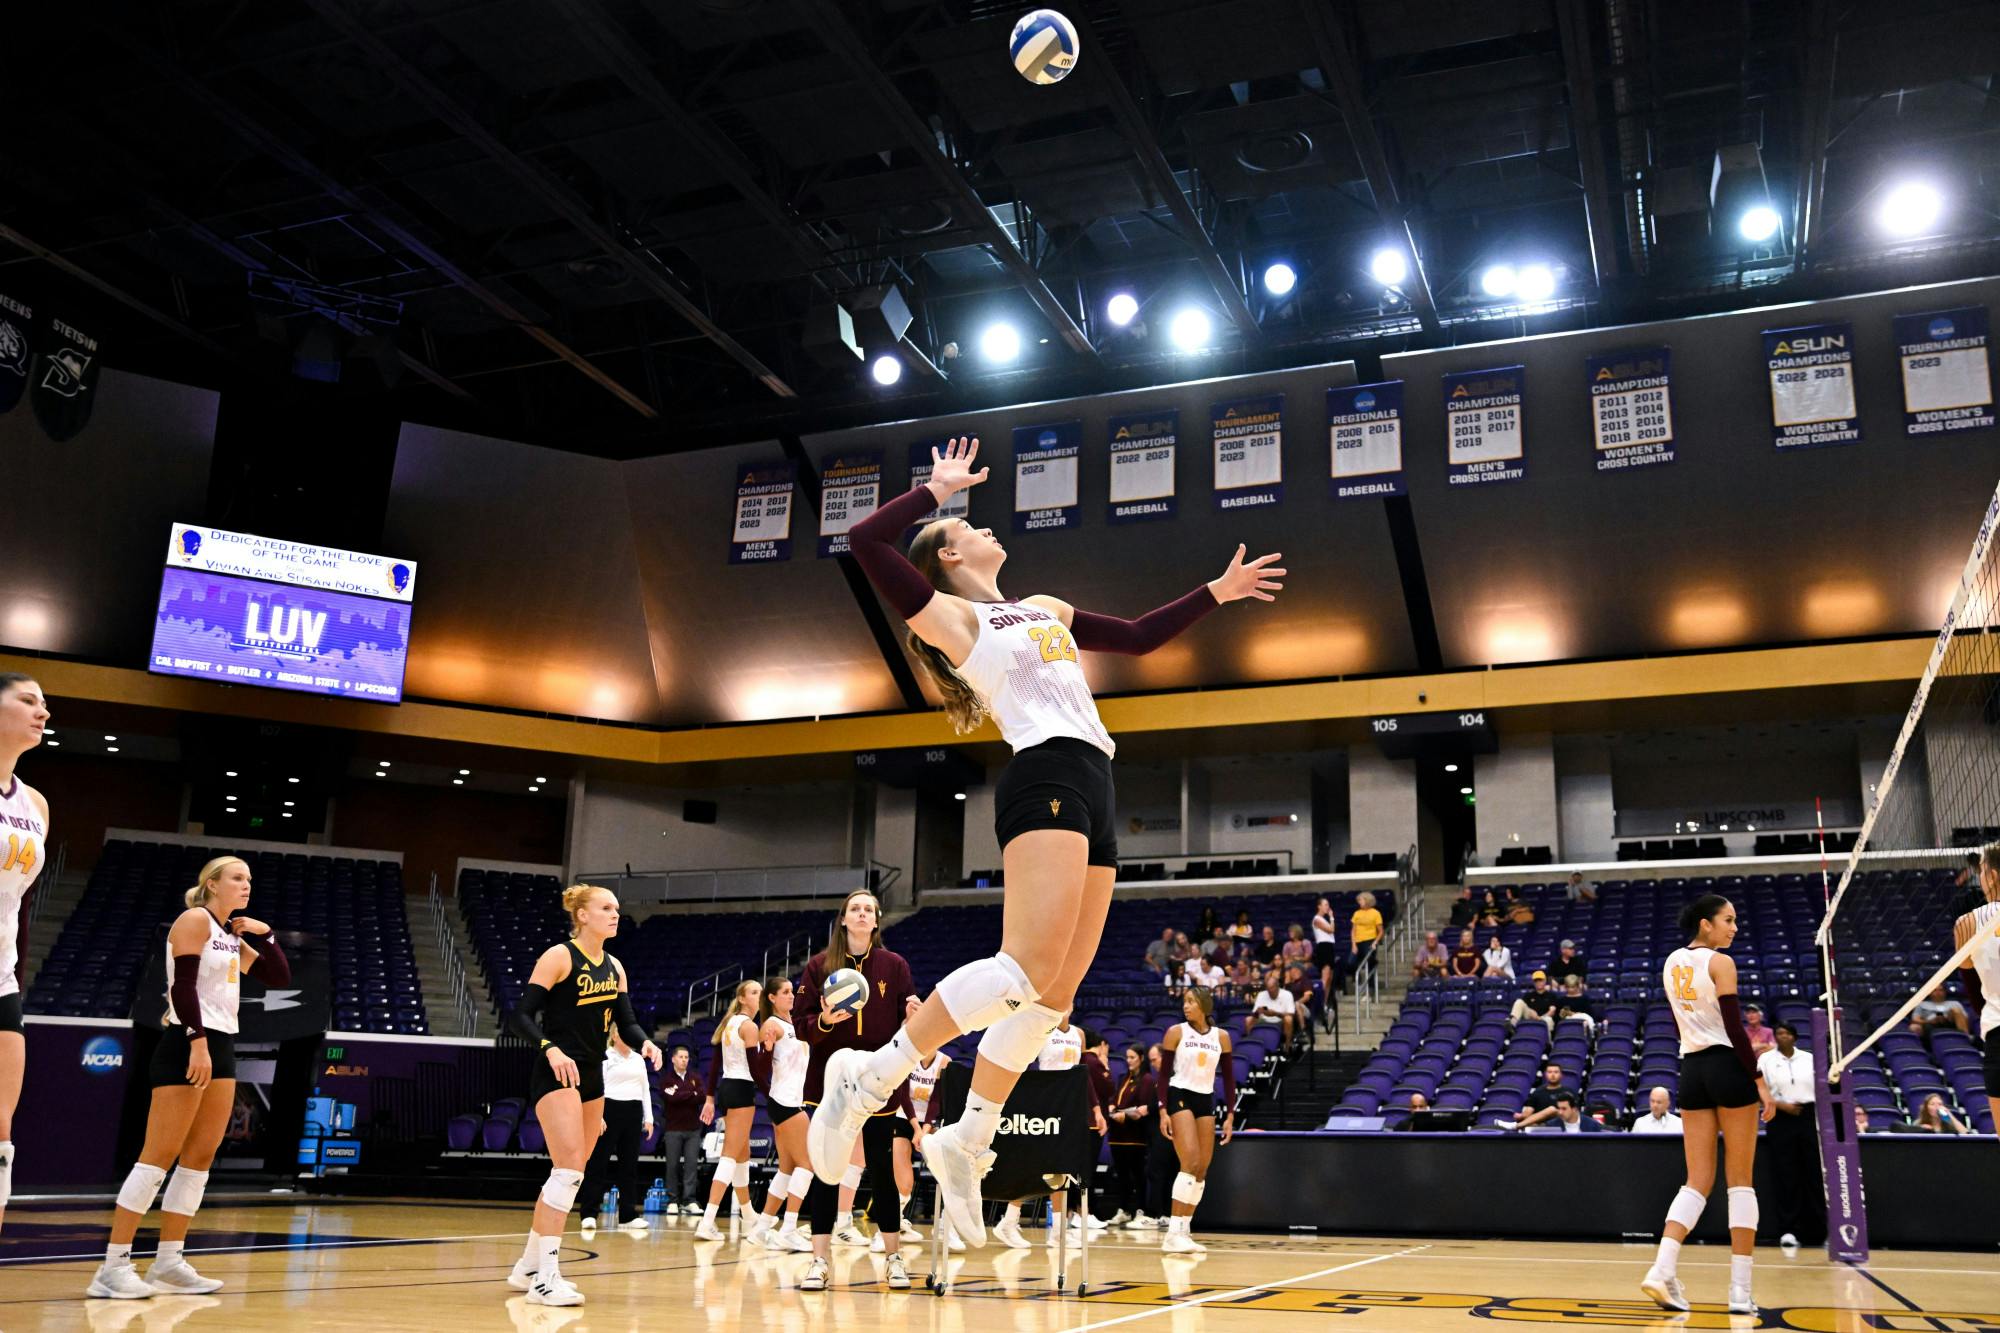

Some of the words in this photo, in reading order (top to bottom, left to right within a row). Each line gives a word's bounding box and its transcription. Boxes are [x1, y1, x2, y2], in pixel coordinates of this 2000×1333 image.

[1773, 334, 1845, 355] ASUN
[1900, 336, 1986, 355] TOURNAMENT
[1769, 352, 1850, 369] CHAMPIONS
[1909, 357, 1941, 369] 2023
[1777, 372, 1807, 383] 2022
[1814, 368, 1845, 379] 2023
[1592, 376, 1668, 394] CHAMPIONS
[1447, 394, 1521, 411] CHAMPIONS
[1600, 397, 1627, 408] 2011
[1634, 392, 1663, 403] 2012
[1333, 409, 1398, 424] REGIONALS
[1600, 408, 1628, 420] 2013
[1635, 404, 1663, 415] 2014
[1916, 407, 1983, 422] WOMEN'S
[1215, 413, 1280, 428] TOURNAMENT
[1601, 420, 1629, 432] 2015
[1908, 422, 1943, 434] CROSS
[1946, 416, 1994, 430] COUNTRY
[1214, 422, 1281, 438] CHAMPIONS
[1369, 424, 1395, 434] 2015
[1455, 425, 1481, 436] 2015
[1488, 421, 1515, 432] 2017
[1784, 421, 1848, 436] WOMEN'S
[1110, 436, 1176, 451] CHAMPIONS
[1250, 436, 1275, 447] 2015
[1337, 439, 1362, 450] 2023
[1776, 435, 1810, 447] CROSS
[1811, 430, 1858, 443] COUNTRY
[1017, 447, 1079, 461] TOURNAMENT
[1116, 453, 1140, 464] 2022
[1146, 450, 1170, 461] 2023
[1220, 451, 1245, 462] 2023
[1605, 443, 1664, 459] WOMEN'S
[1467, 461, 1505, 473] MEN'S
[1597, 458, 1628, 470] CROSS
[1631, 452, 1674, 465] COUNTRY
[824, 465, 880, 477] TOURNAMENT
[1022, 465, 1045, 475] 2023
[1449, 473, 1479, 484] CROSS
[1481, 469, 1523, 481] COUNTRY
[822, 474, 880, 486] CHAMPIONS
[738, 483, 793, 495] CHAMPIONS
[826, 490, 848, 499] 2017
[1339, 483, 1396, 497] BASEBALL
[826, 502, 847, 511] 2021
[853, 498, 874, 508] 2022
[1221, 494, 1276, 508] BASEBALL
[825, 512, 846, 521] 2023
[1030, 509, 1062, 519] MEN'S
[1116, 503, 1168, 516] BASEBALL
[1026, 517, 1066, 529] SOCCER
[746, 541, 774, 551] MEN'S
[741, 550, 777, 559] SOCCER
[245, 602, 327, 648] LUV
[989, 614, 1026, 630] SUN
[1028, 625, 1077, 663] 22
[228, 665, 261, 679] BUTLER
[315, 676, 339, 689] STATE
[355, 681, 398, 696] LIPSCOMB
[1372, 719, 1398, 732] 105
[1459, 713, 1485, 727] 104
[856, 753, 876, 765] 106
[926, 750, 946, 762] 105
[1704, 808, 1786, 825] LIPSCOMB
[3, 833, 37, 875] 14
[1671, 965, 1697, 1000] 12
[82, 1054, 122, 1067] NCAA
[327, 1047, 344, 1059] EXIT
[997, 1114, 1060, 1135] olten
